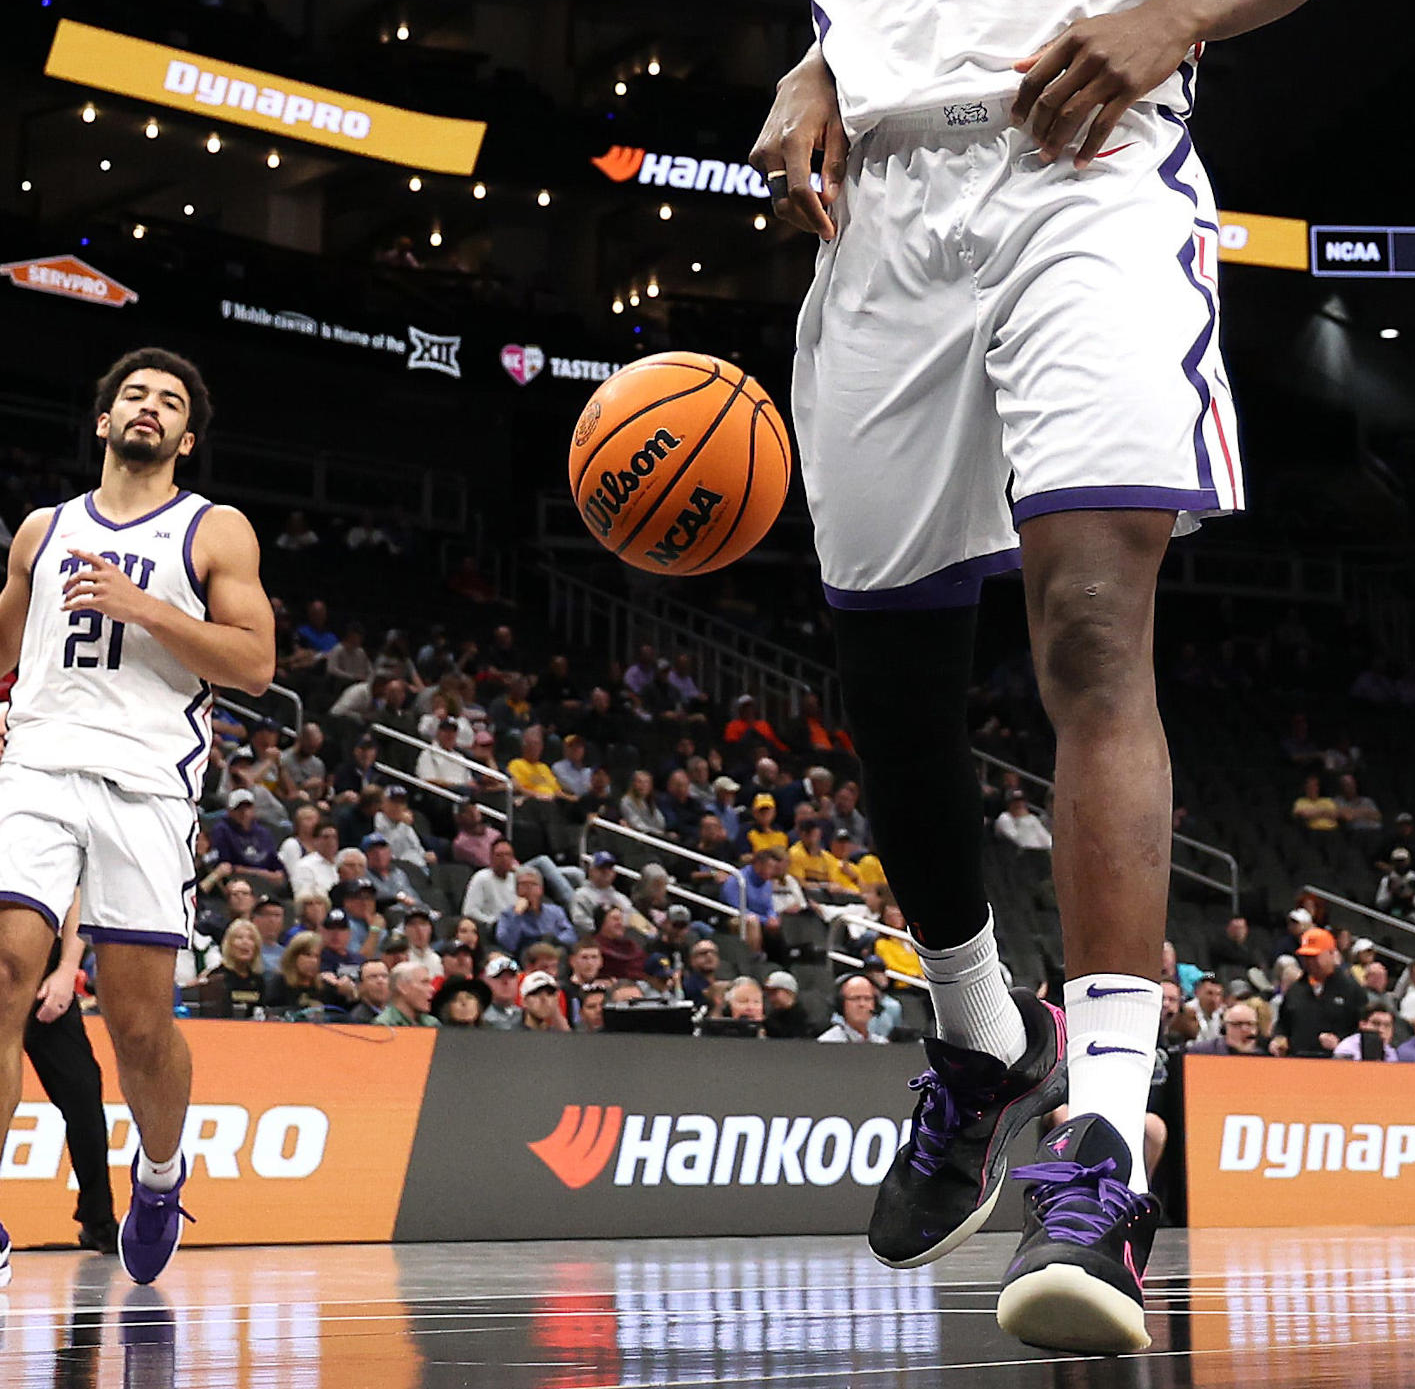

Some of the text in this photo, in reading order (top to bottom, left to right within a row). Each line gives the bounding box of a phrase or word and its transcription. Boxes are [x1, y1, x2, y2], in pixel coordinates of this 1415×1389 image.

[1325, 242, 1381, 262] NCAA
[29, 264, 108, 296] SERVPRO
[550, 357, 611, 381] TASTES
[584, 427, 681, 537] Wilson
[645, 485, 723, 566] NCAA
[64, 609, 125, 670] 21
